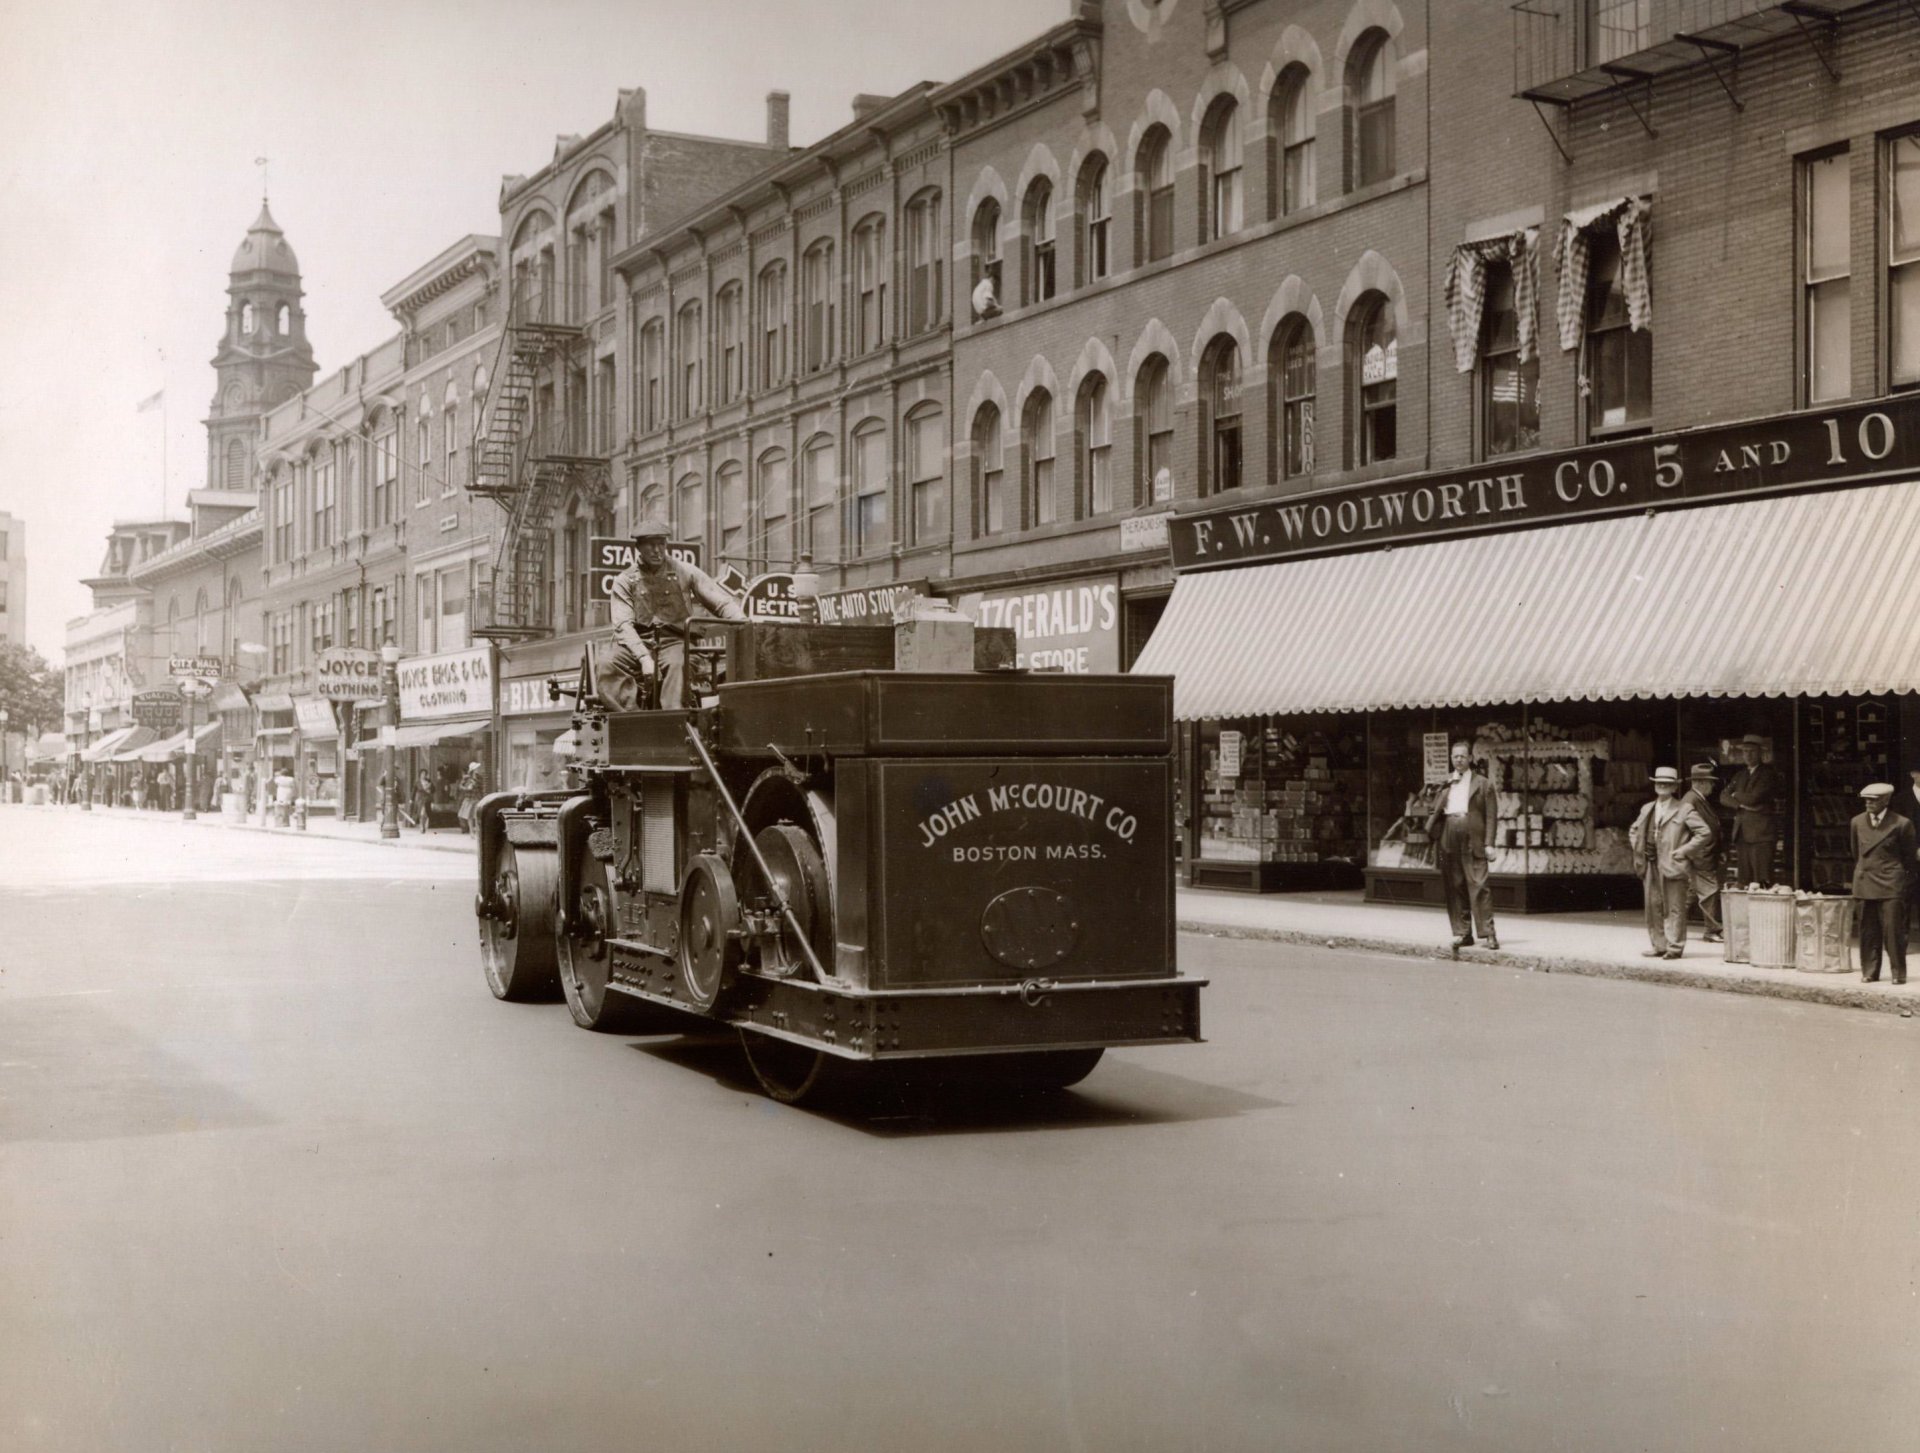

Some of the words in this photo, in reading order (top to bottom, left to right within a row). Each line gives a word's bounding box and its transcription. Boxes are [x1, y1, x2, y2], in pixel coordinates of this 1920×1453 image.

[1303, 404, 1313, 474] RADIO
[1192, 519, 1223, 555] F.
[1229, 512, 1270, 548] W.
[1277, 473, 1528, 541] WOOLWORTH
[1554, 459, 1628, 502] CO.
[1653, 444, 1684, 488] 5
[1713, 440, 1791, 473] AND
[1823, 412, 1896, 465] 10
[171, 659, 194, 668] CITY
[196, 659, 220, 668] HALL
[320, 660, 378, 676] JOYCE
[1030, 647, 1088, 673] STORE
[401, 667, 428, 690] JOYCE
[462, 661, 469, 682] &
[318, 684, 379, 696] CLOTHING
[419, 689, 467, 708] CLOTHING
[918, 794, 982, 848] JOHN
[952, 846, 1037, 862] BOSTON
[1046, 844, 1107, 860] MASS.
